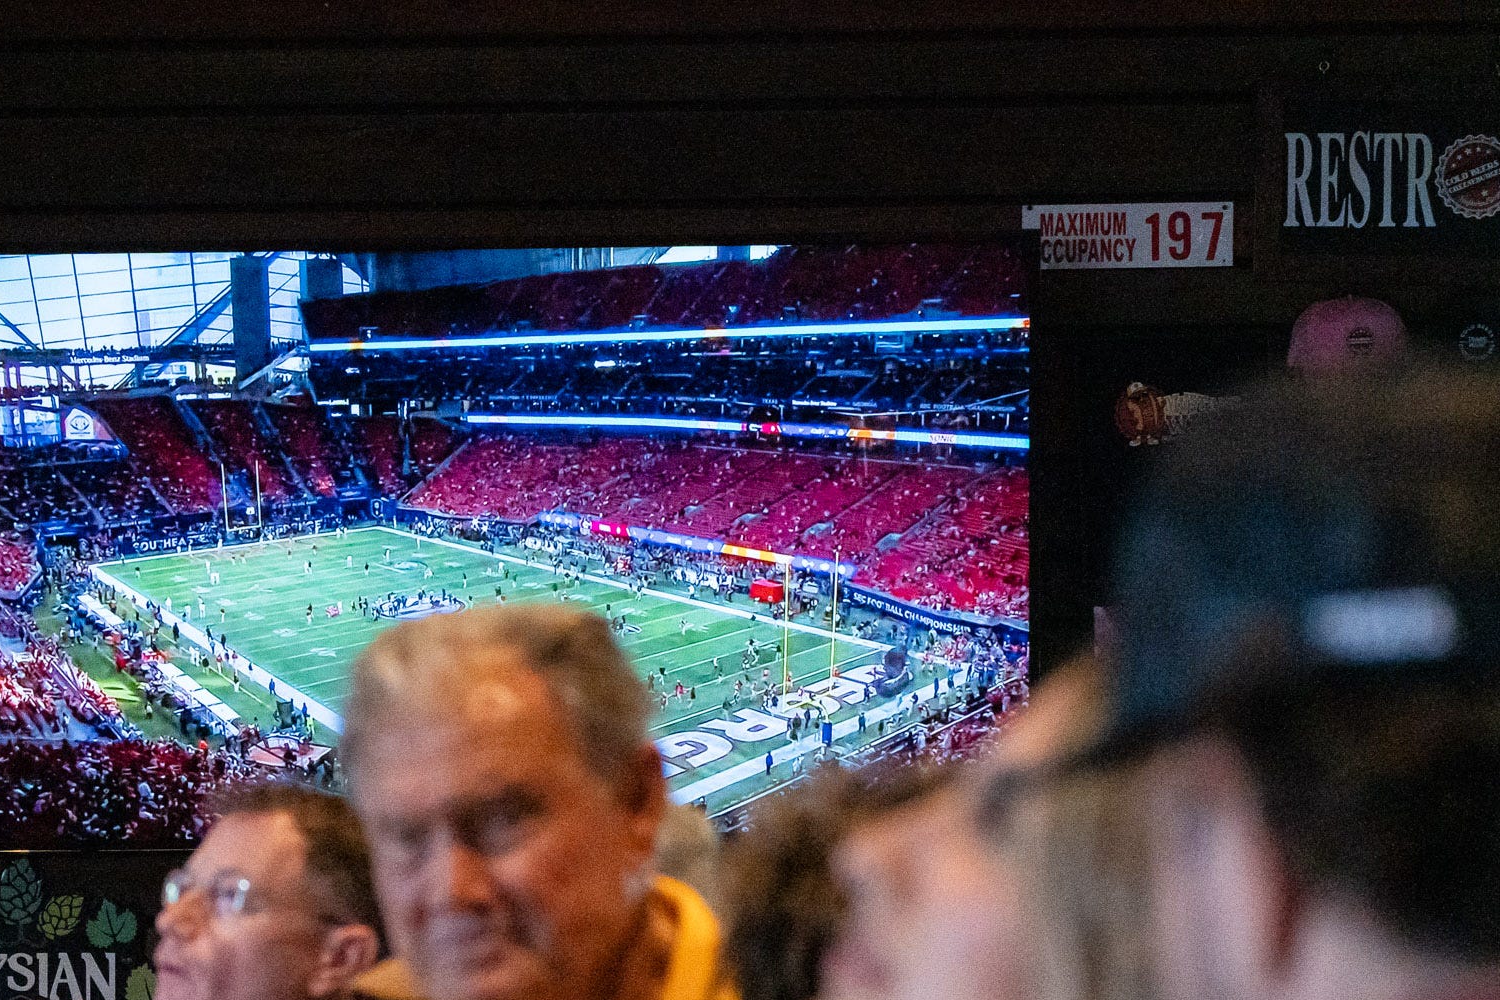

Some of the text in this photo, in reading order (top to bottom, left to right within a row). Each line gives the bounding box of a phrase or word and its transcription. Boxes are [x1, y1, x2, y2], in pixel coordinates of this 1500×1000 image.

[1283, 130, 1437, 229] RESTR
[1040, 212, 1127, 237] MAXIMUM
[1145, 210, 1224, 262] 197
[1040, 238, 1137, 264] CCUPANCY
